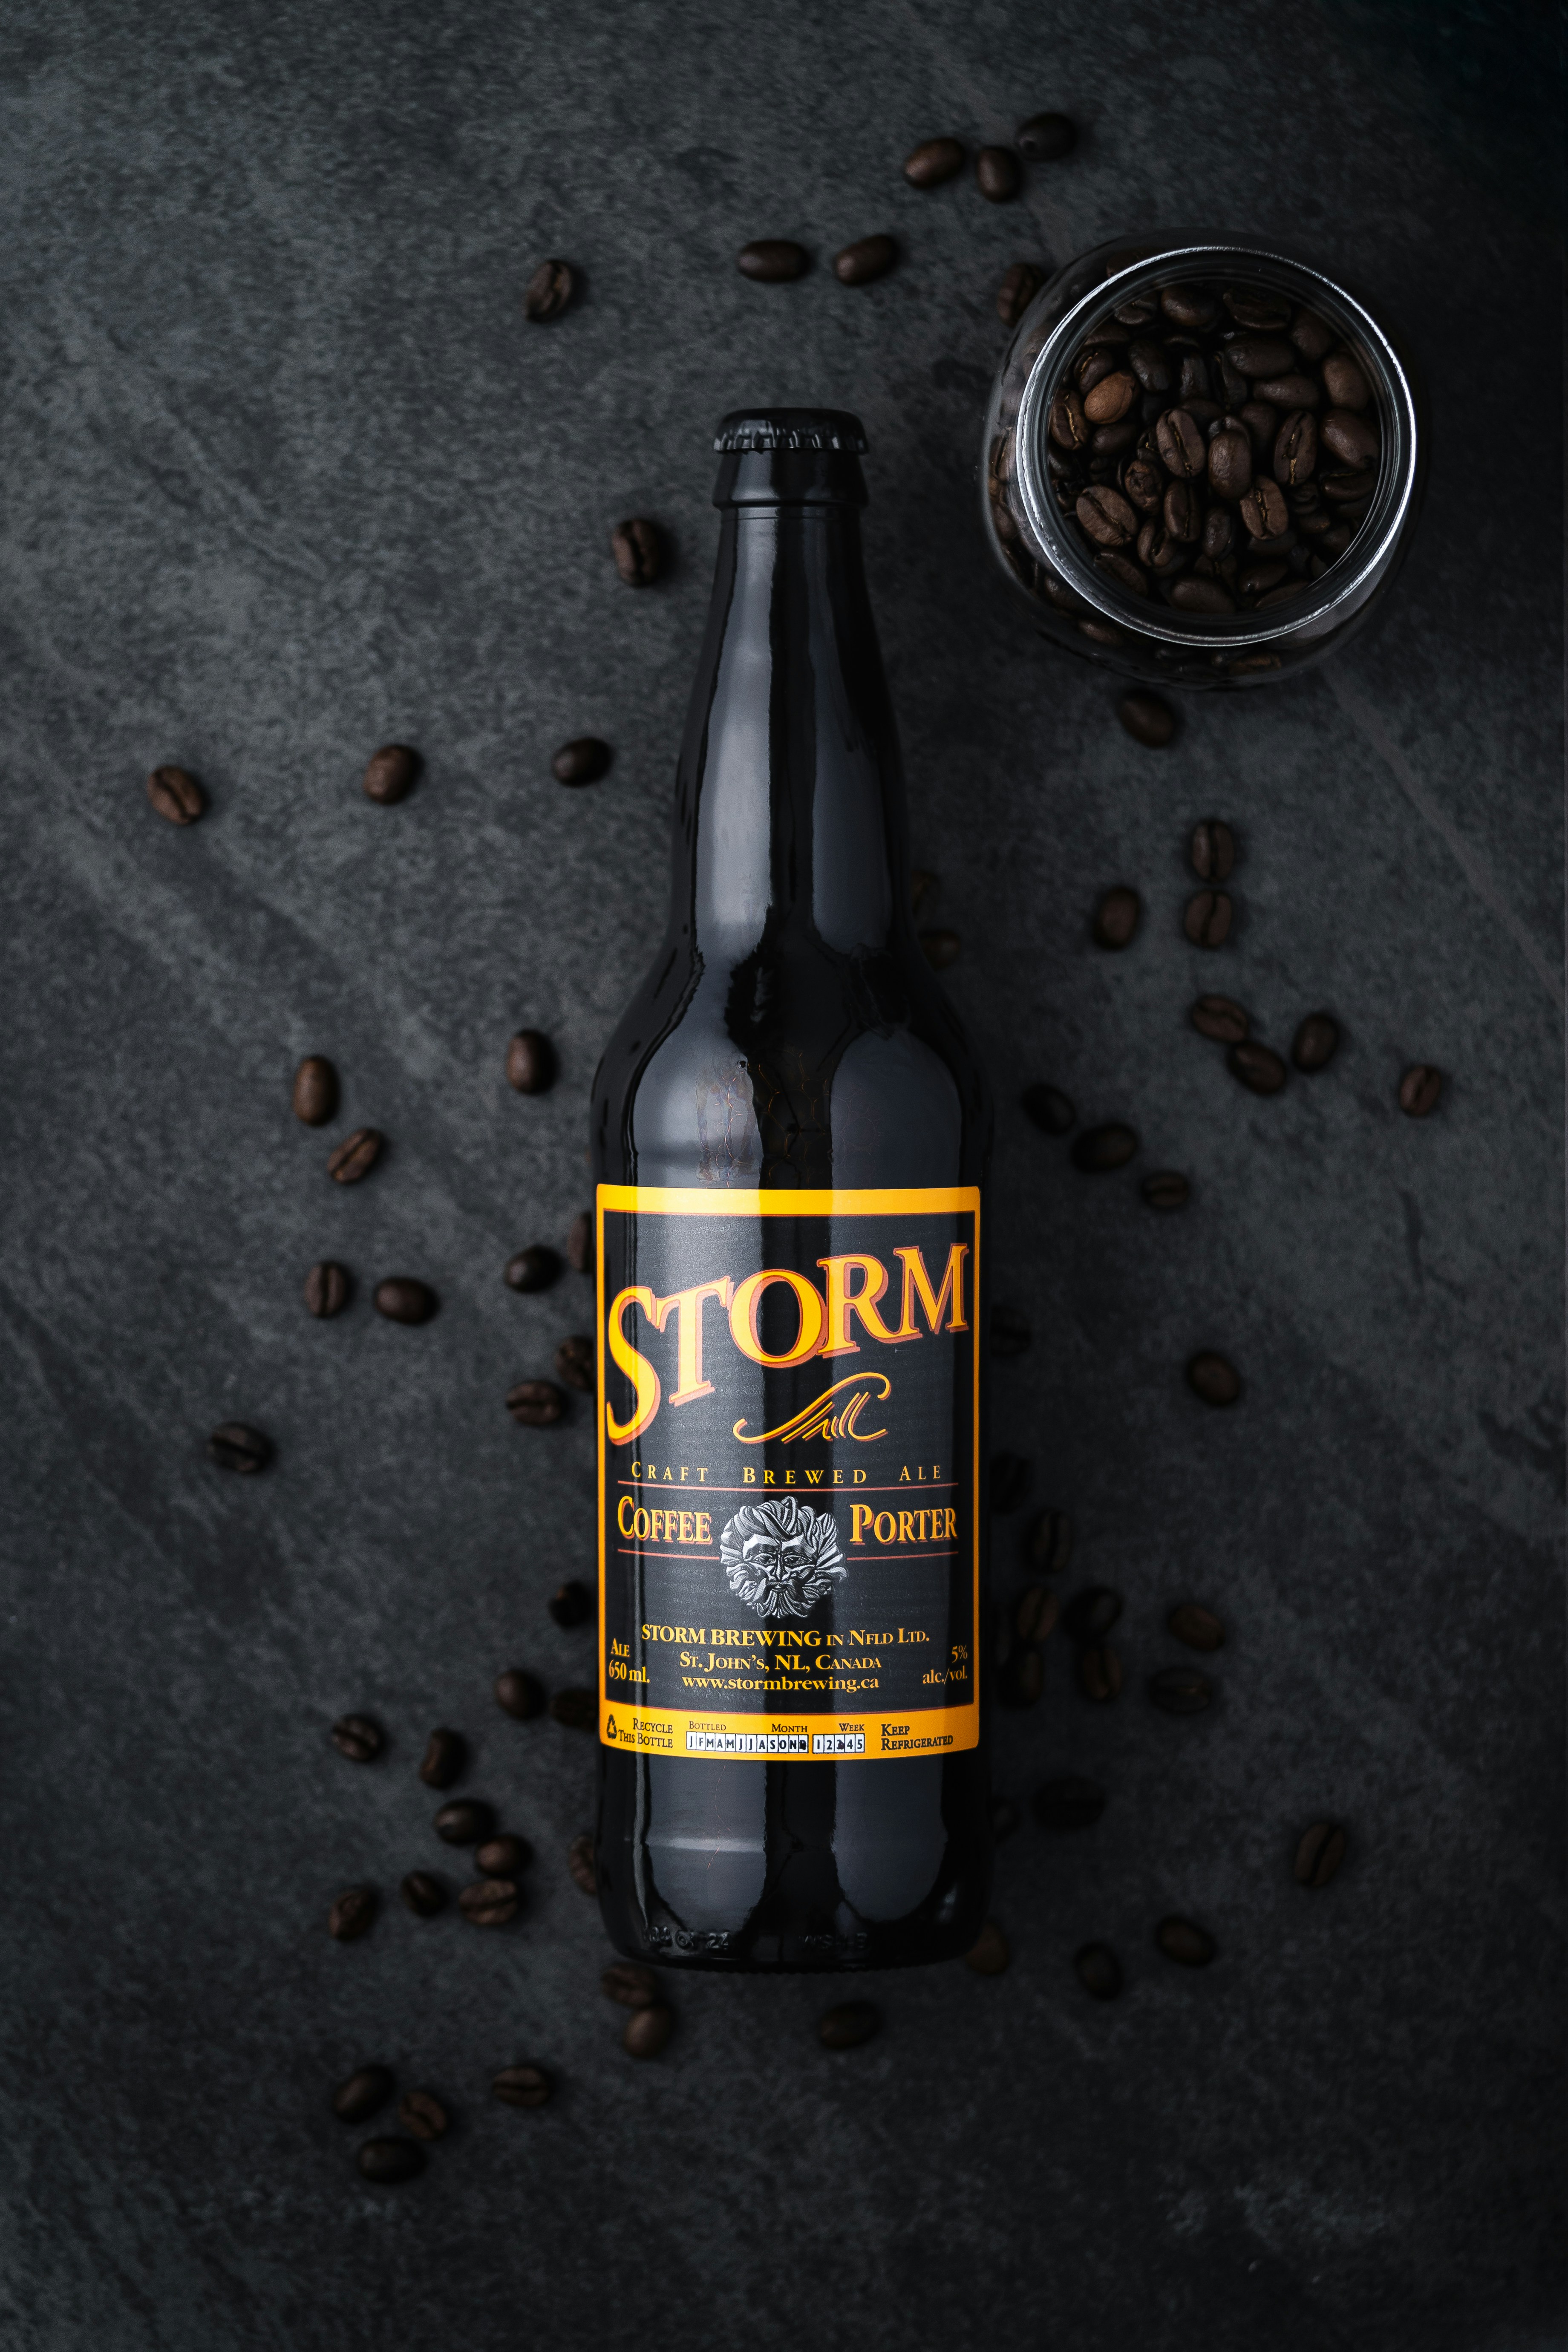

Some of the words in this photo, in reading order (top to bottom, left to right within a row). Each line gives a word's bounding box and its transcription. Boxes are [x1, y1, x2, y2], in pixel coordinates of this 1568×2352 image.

[606, 1243, 969, 1446] STORM
[631, 1461, 709, 1482] CRAFT
[743, 1467, 867, 1484] BREWED
[899, 1465, 940, 1481] ALE
[617, 1495, 711, 1544] COFFEE
[850, 1504, 957, 1545] PORTER
[641, 1624, 706, 1645] STORM
[711, 1629, 822, 1646] BREWING
[827, 1635, 843, 1646] IN
[849, 1630, 894, 1646] NFLD
[899, 1628, 930, 1643] LTD.
[611, 1638, 630, 1657] ALE
[951, 1646, 968, 1663] 5%
[608, 1660, 627, 1680] 650
[629, 1666, 650, 1683] ml.
[680, 1651, 703, 1668] ST.
[775, 1654, 810, 1673] NL,
[815, 1654, 882, 1670] CANADA
[922, 1665, 968, 1684] alc./vol.
[682, 1676, 879, 1693] www.stormbrewing.ca
[632, 1718, 673, 1734] RECYCLE
[689, 1721, 726, 1731] BOTTLED
[771, 1723, 808, 1733] MONTH
[838, 1723, 865, 1732] WEEK
[881, 1723, 910, 1736] KEEP
[618, 1729, 635, 1744] THIS
[637, 1731, 673, 1748] BOTTLE
[881, 1735, 954, 1751] REFRIGERATED
